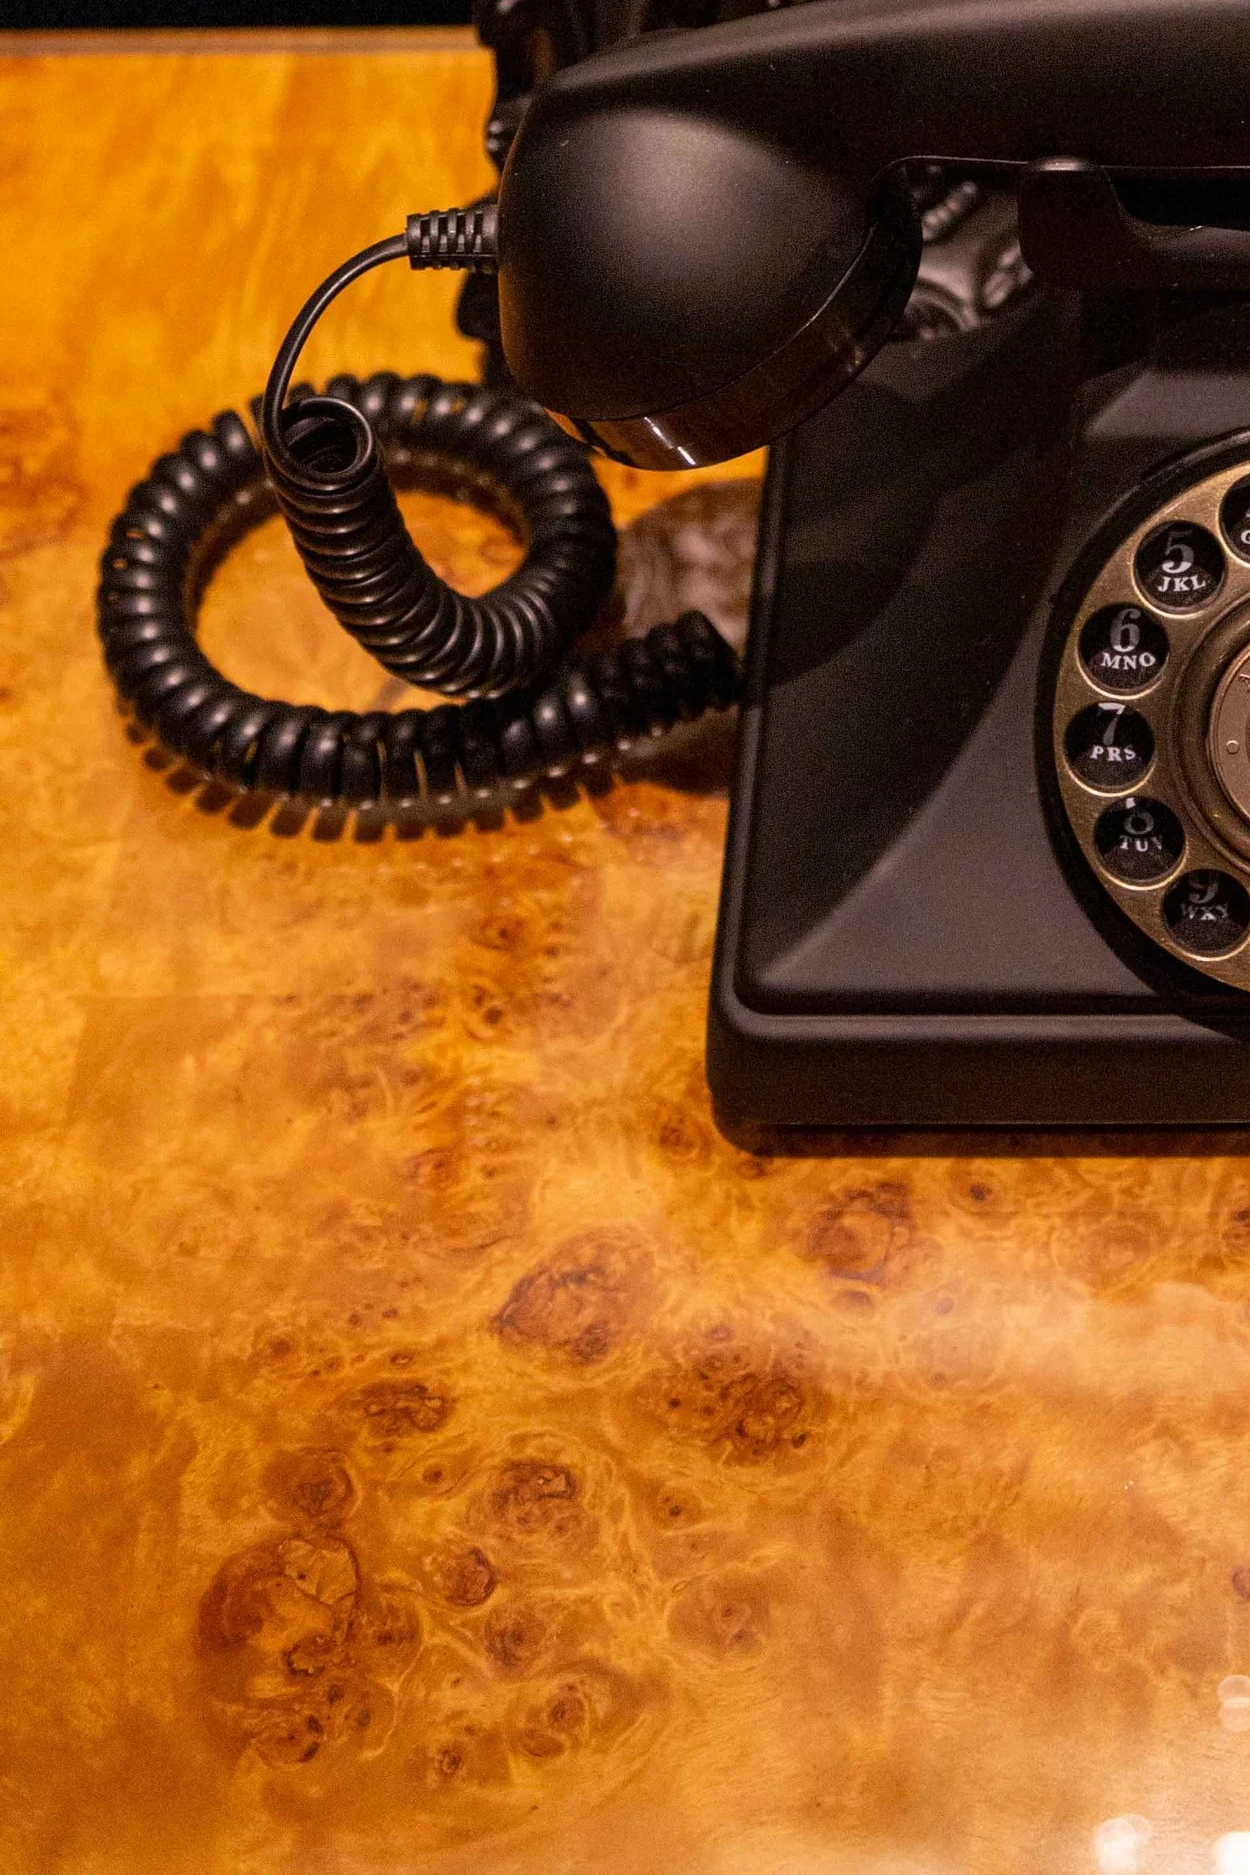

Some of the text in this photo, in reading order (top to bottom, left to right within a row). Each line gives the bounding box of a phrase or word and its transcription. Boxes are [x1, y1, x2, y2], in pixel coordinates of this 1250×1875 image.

[1161, 529, 1195, 574] 5
[1157, 575, 1206, 593] JKL
[1110, 608, 1142, 653] 6
[1100, 652, 1156, 670] MNO
[1098, 701, 1126, 746] 7
[1090, 744, 1136, 762] PRS
[1123, 797, 1154, 835] 8
[1188, 874, 1219, 905] 9
[1180, 901, 1229, 921] WXY
